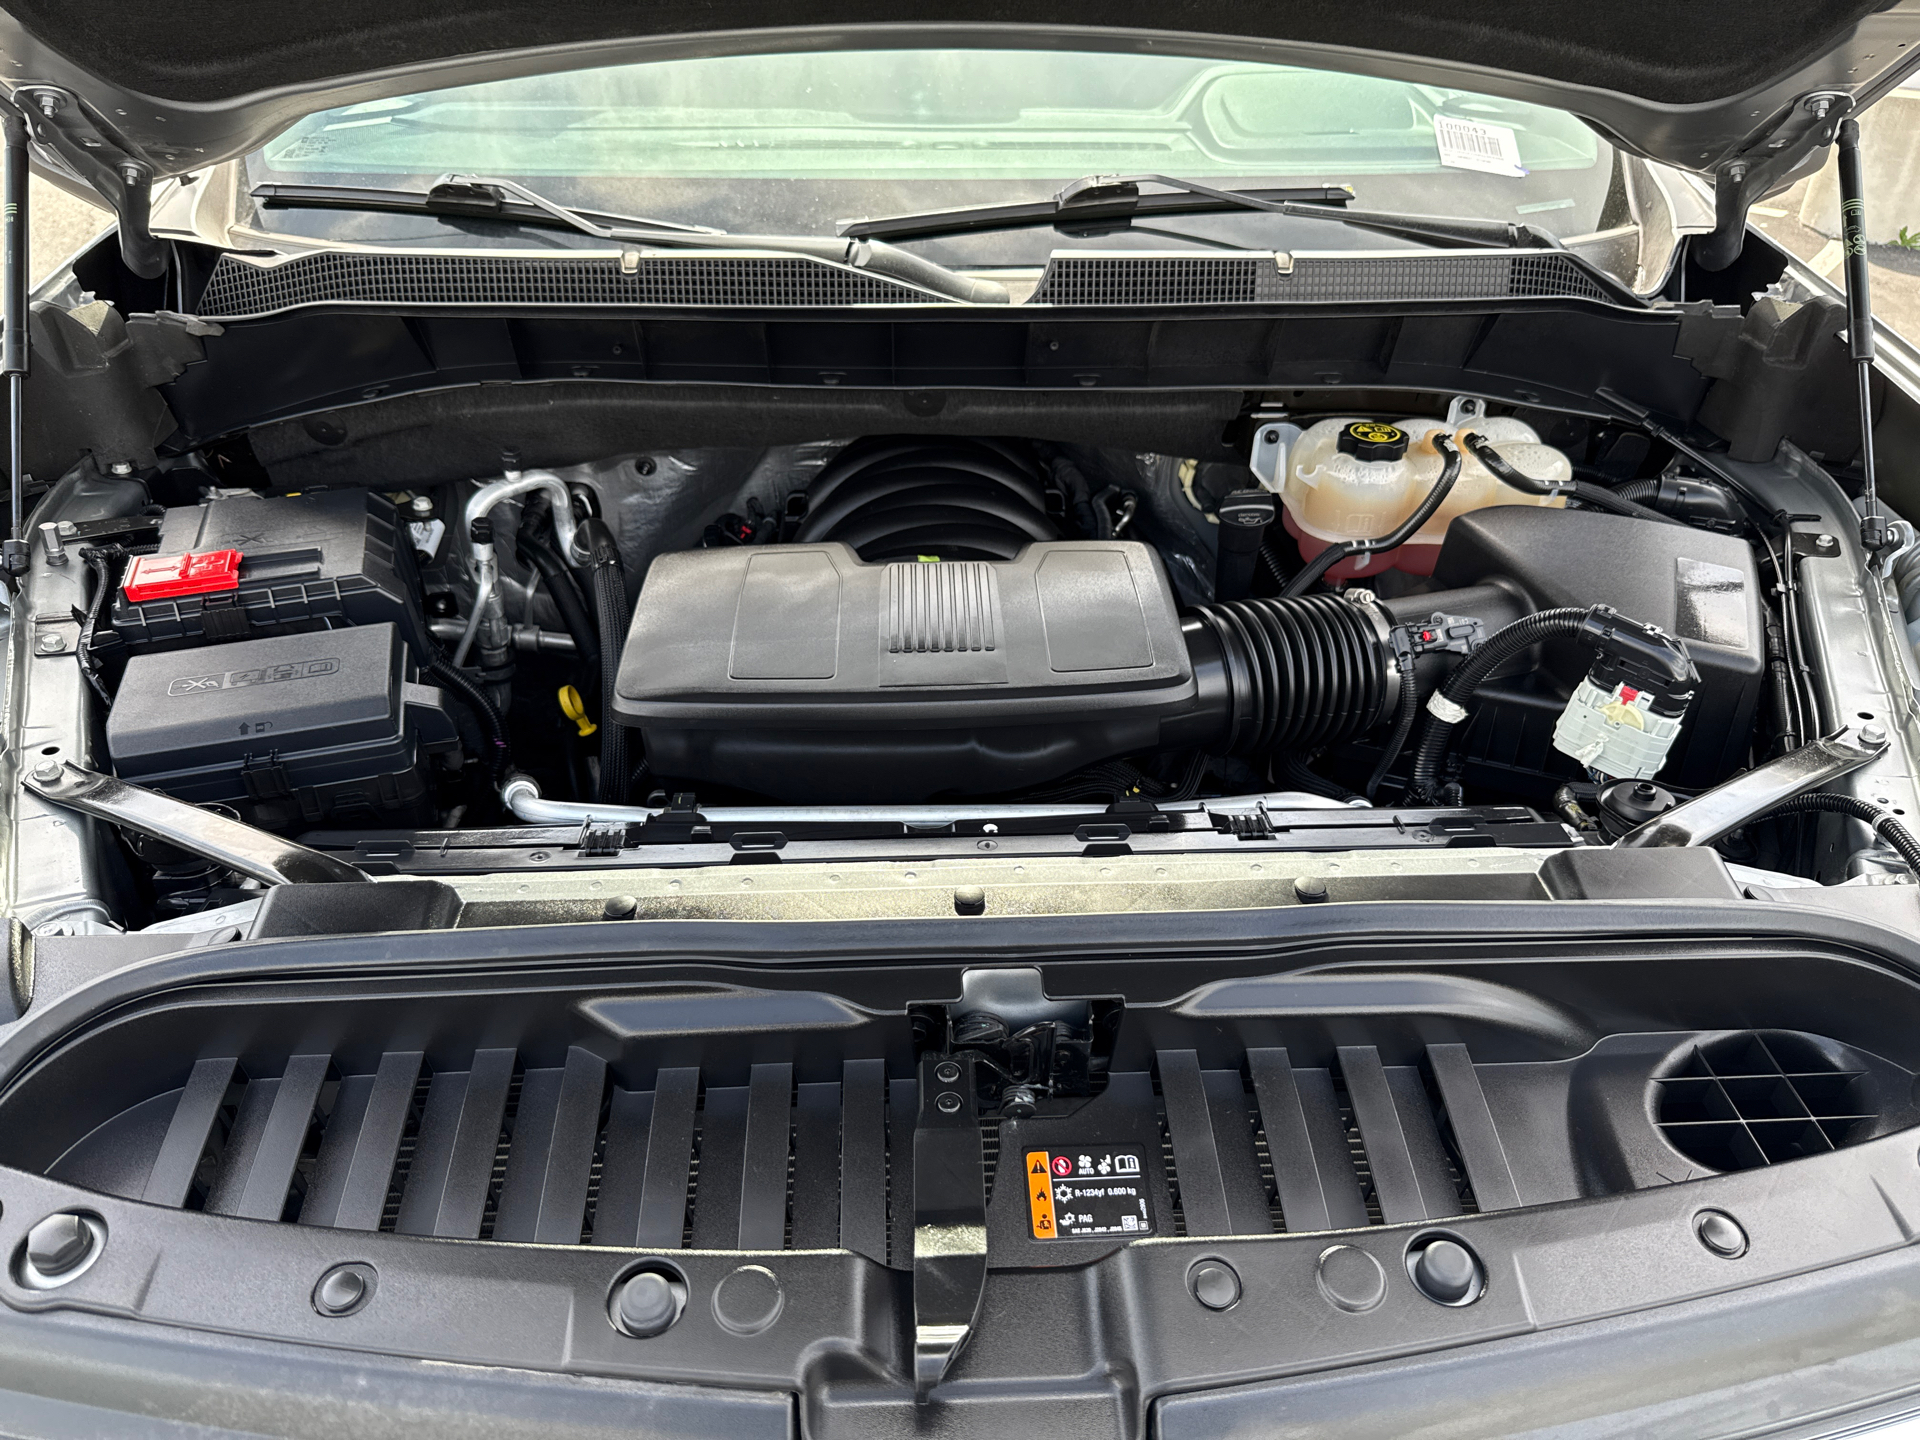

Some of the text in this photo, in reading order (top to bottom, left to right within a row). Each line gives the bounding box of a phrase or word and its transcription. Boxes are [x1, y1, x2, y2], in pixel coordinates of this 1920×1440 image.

[1074, 1188, 1104, 1198] R-1234yf
[1127, 1186, 1136, 1196] kg
[1078, 1214, 1094, 1223] PAG
